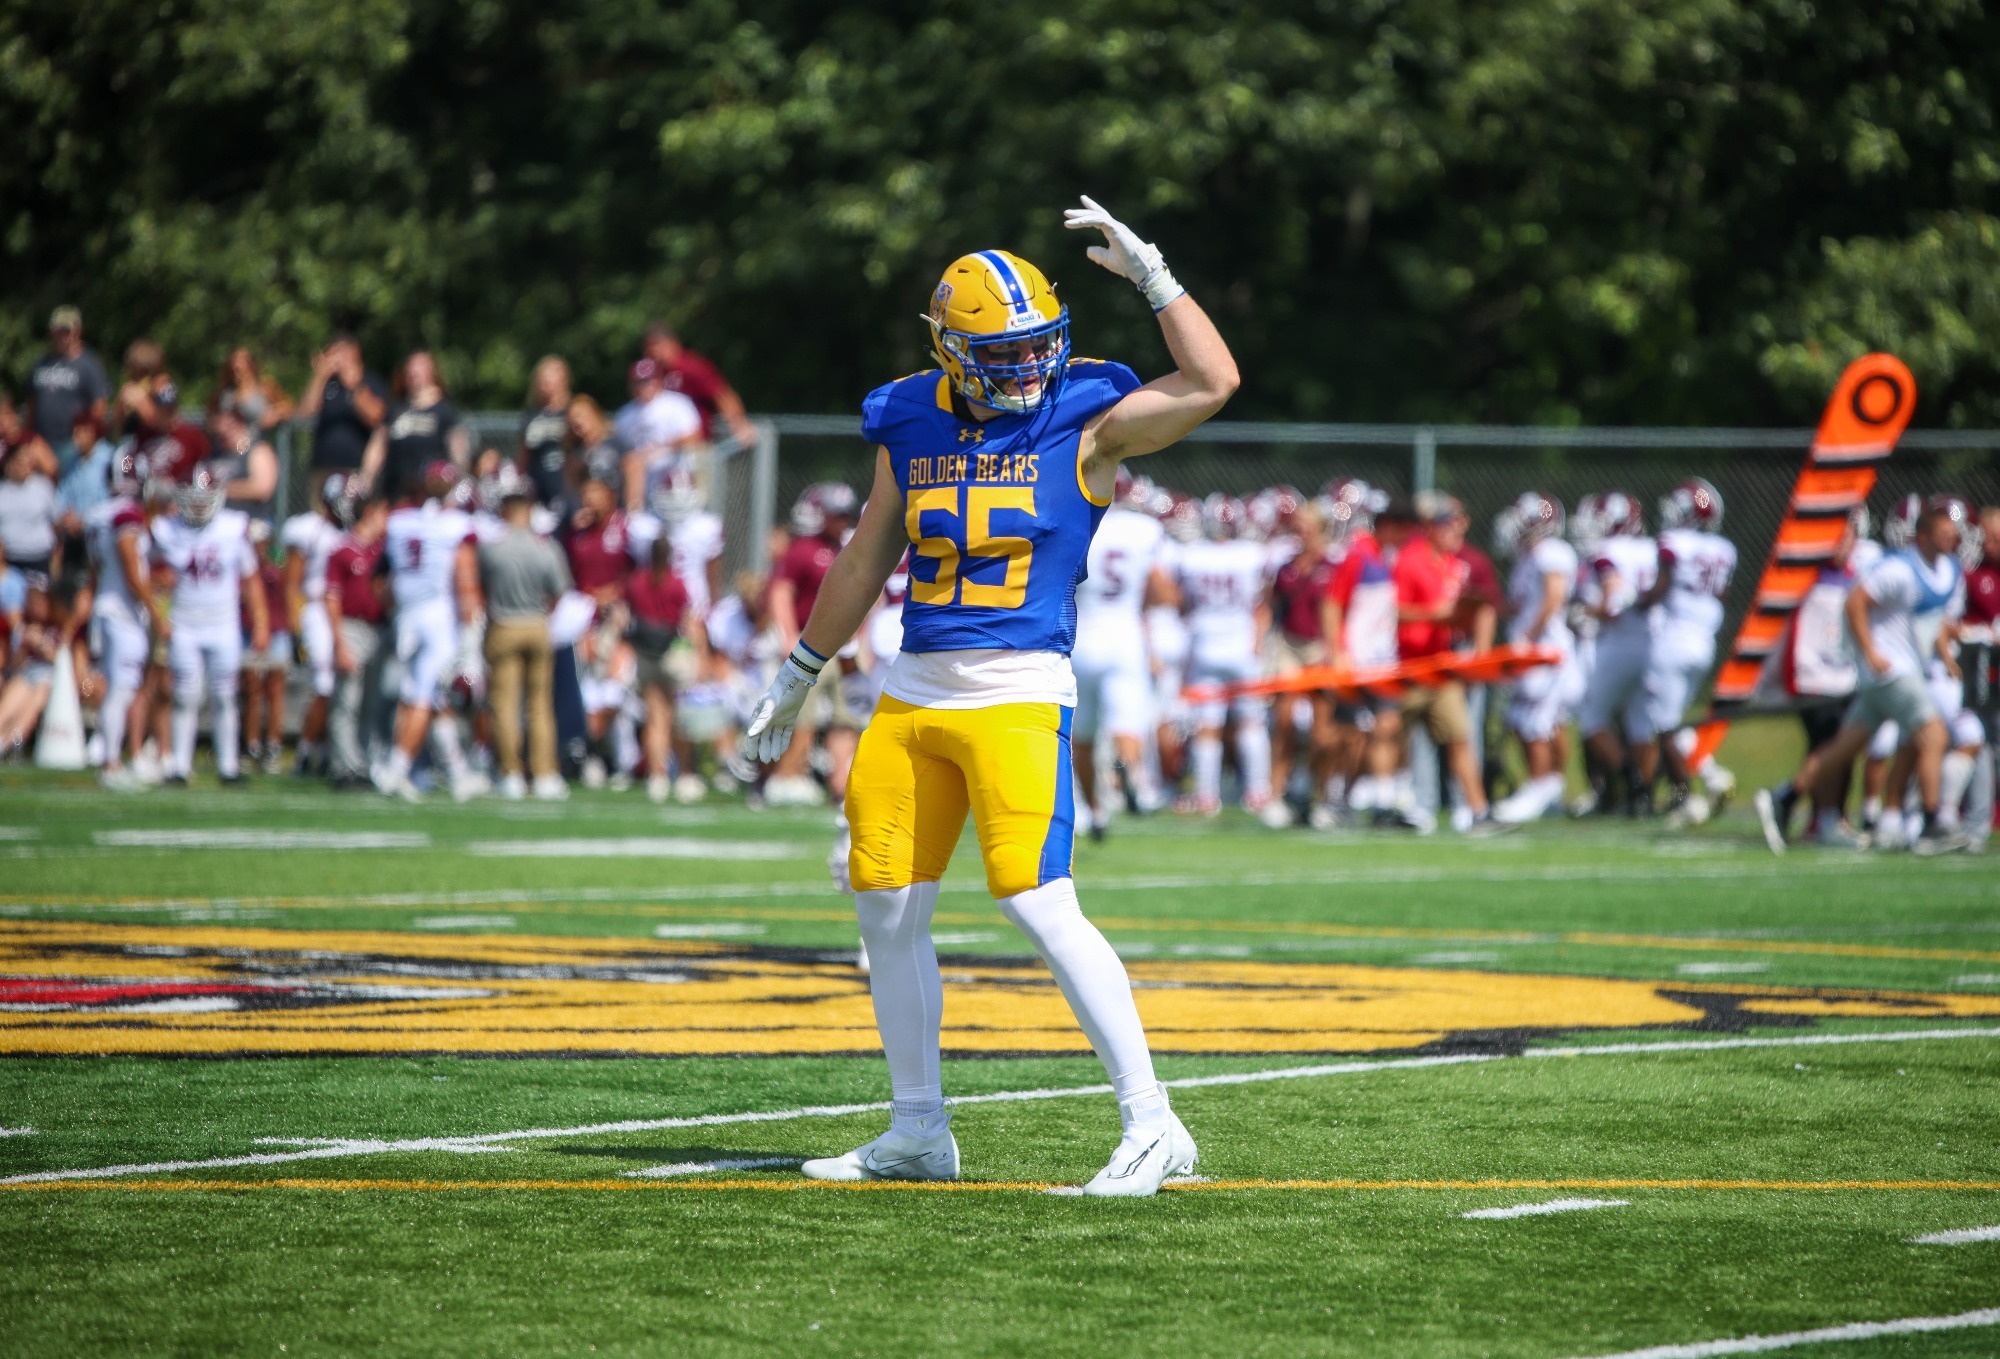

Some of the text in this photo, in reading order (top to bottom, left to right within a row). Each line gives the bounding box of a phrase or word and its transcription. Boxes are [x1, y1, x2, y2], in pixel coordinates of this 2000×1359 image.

[1016, 314, 1035, 323] BEARS
[909, 454, 1040, 486] GOLDEN BEARS
[904, 486, 1038, 609] 55
[1101, 550, 1125, 602] 5
